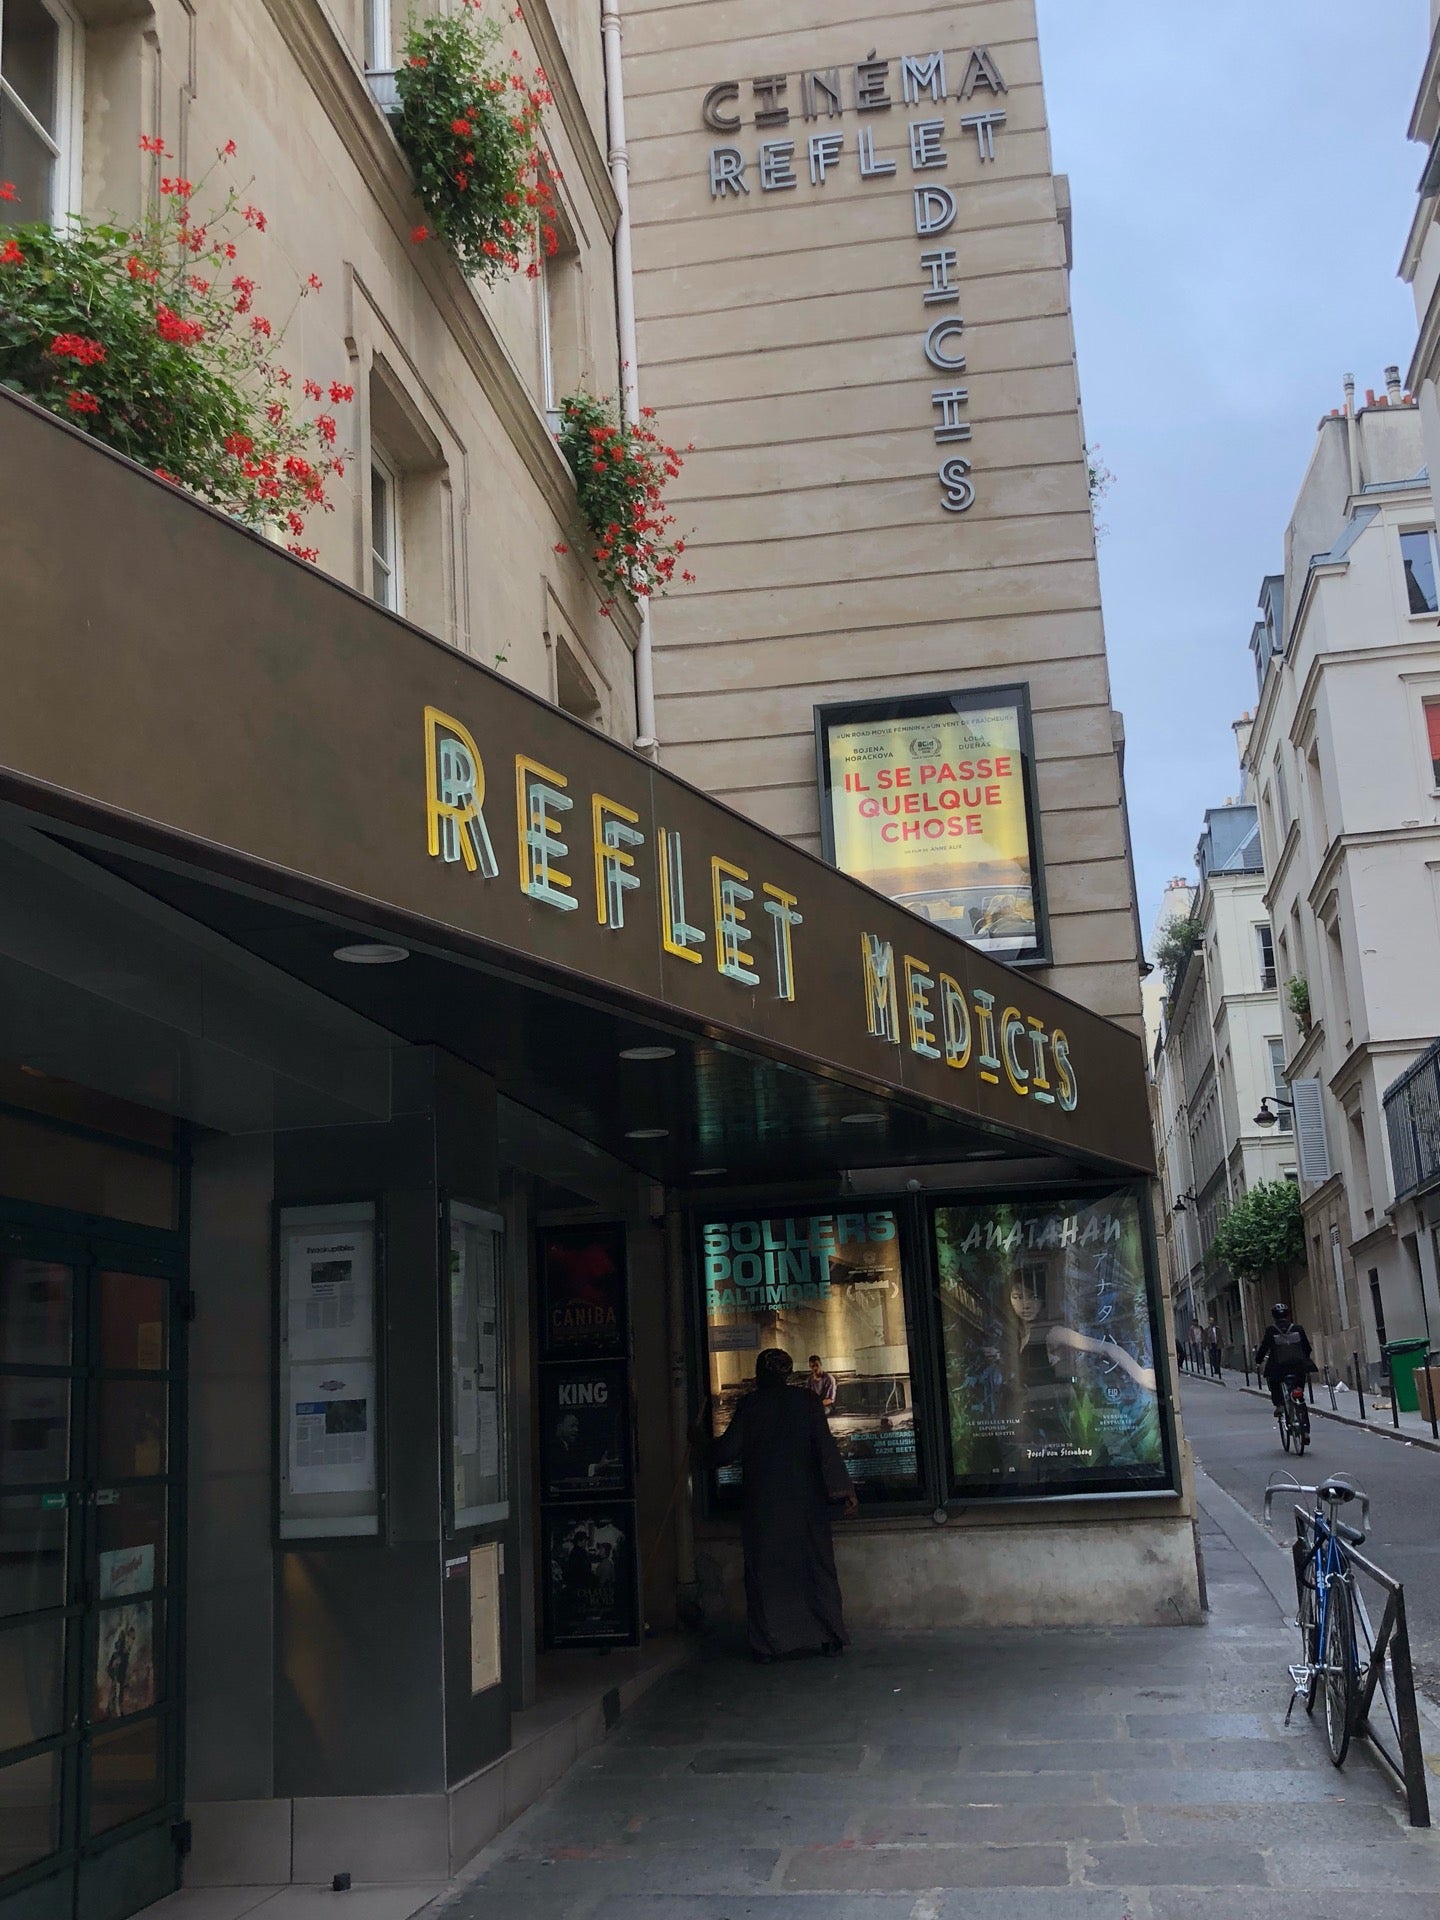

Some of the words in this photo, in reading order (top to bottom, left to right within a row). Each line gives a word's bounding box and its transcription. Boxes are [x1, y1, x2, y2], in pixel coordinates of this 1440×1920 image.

[702, 46, 1008, 131] CINÉMA
[709, 109, 1007, 198] REFLET
[872, 728, 892, 736] MOVIE
[845, 752, 894, 762] HORACKOVA
[853, 746, 885, 754] BOJENA
[844, 772, 870, 794] IL
[877, 767, 912, 791] SE
[920, 756, 1013, 785] PASSE
[858, 785, 1002, 818] QUELQUE
[880, 814, 984, 843] CHOSE
[424, 705, 803, 1002] REFLET
[860, 930, 1078, 1112] MEDICIS
[703, 1210, 896, 1255] SOLLERS
[960, 1214, 1121, 1254] ANATAHAN
[705, 1247, 837, 1290] POINT
[706, 1281, 832, 1308] BALTIMORE
[552, 1306, 617, 1327] CANIBA
[558, 1381, 609, 1405] KING
